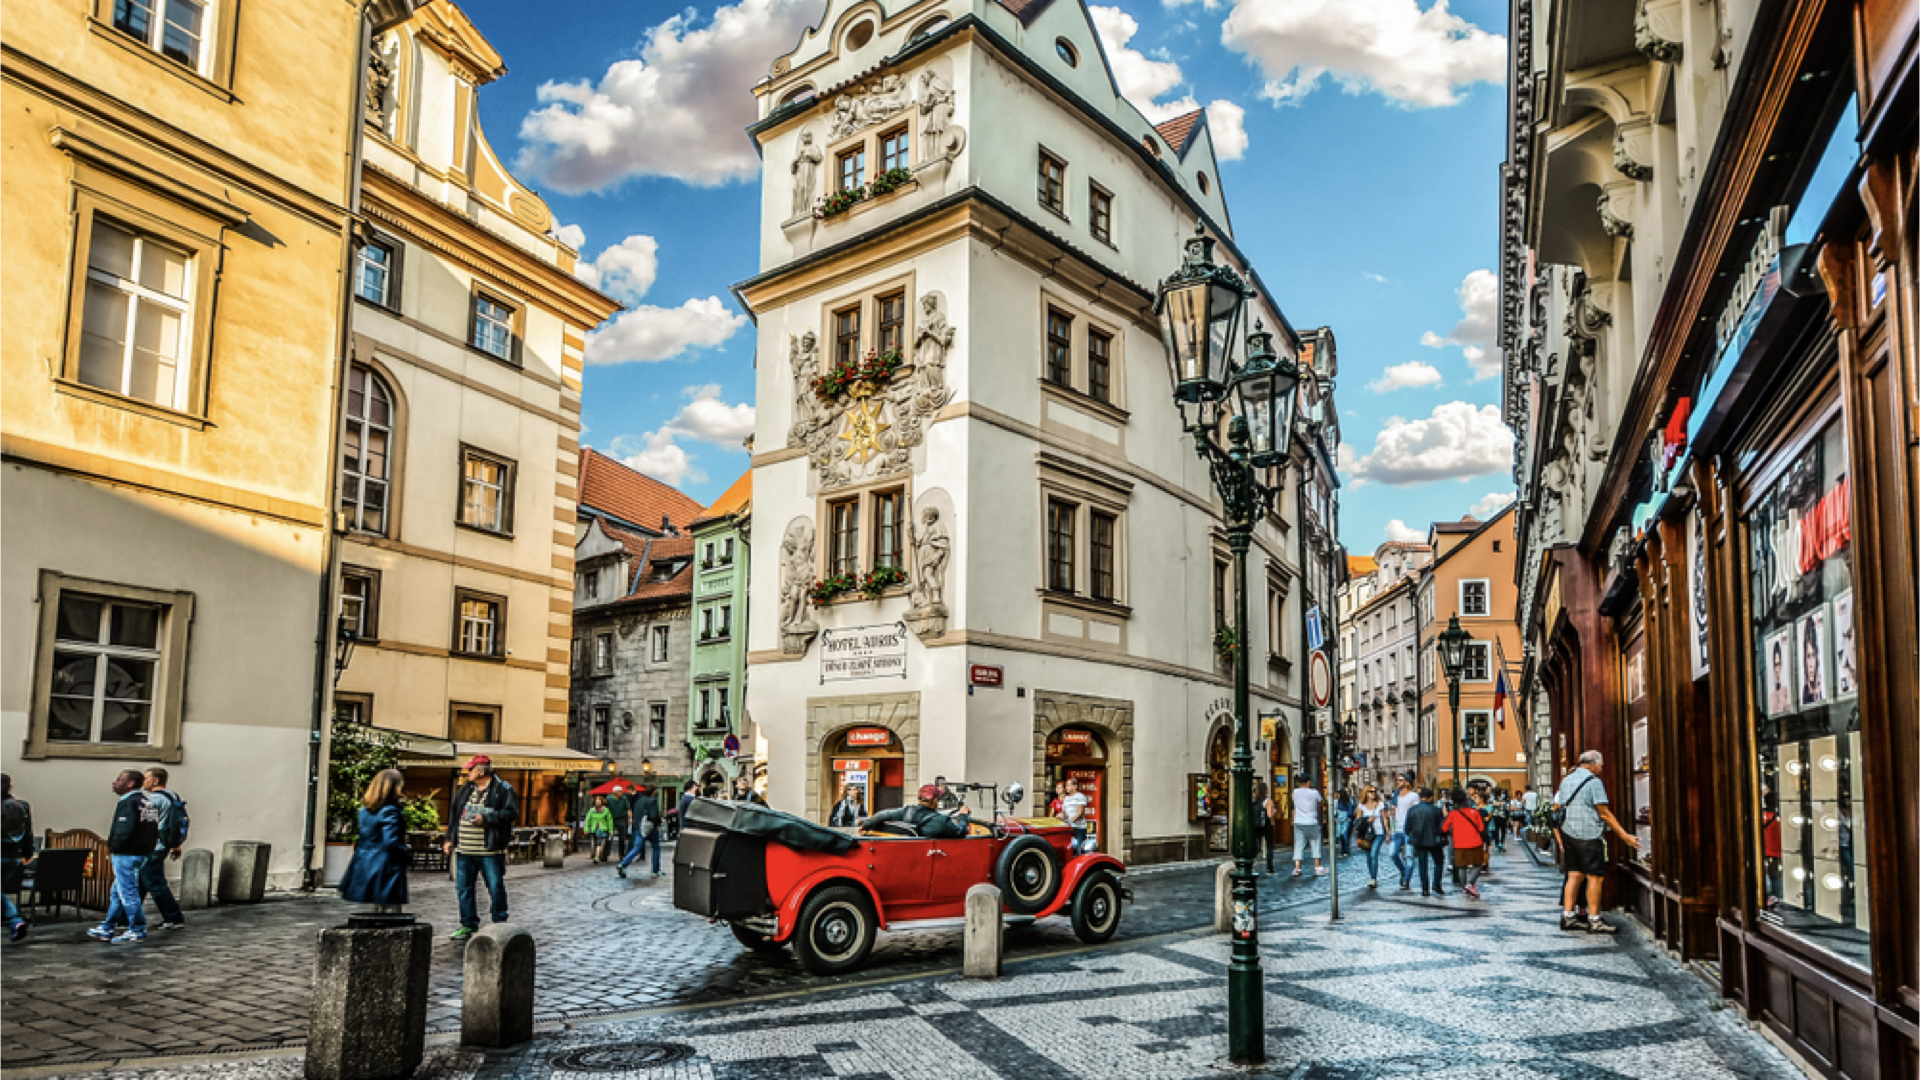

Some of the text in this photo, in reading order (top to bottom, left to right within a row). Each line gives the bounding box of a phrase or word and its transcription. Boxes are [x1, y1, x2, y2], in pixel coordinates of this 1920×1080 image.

[828, 634, 898, 652] HOTEL AURUS
[850, 731, 886, 741] change
